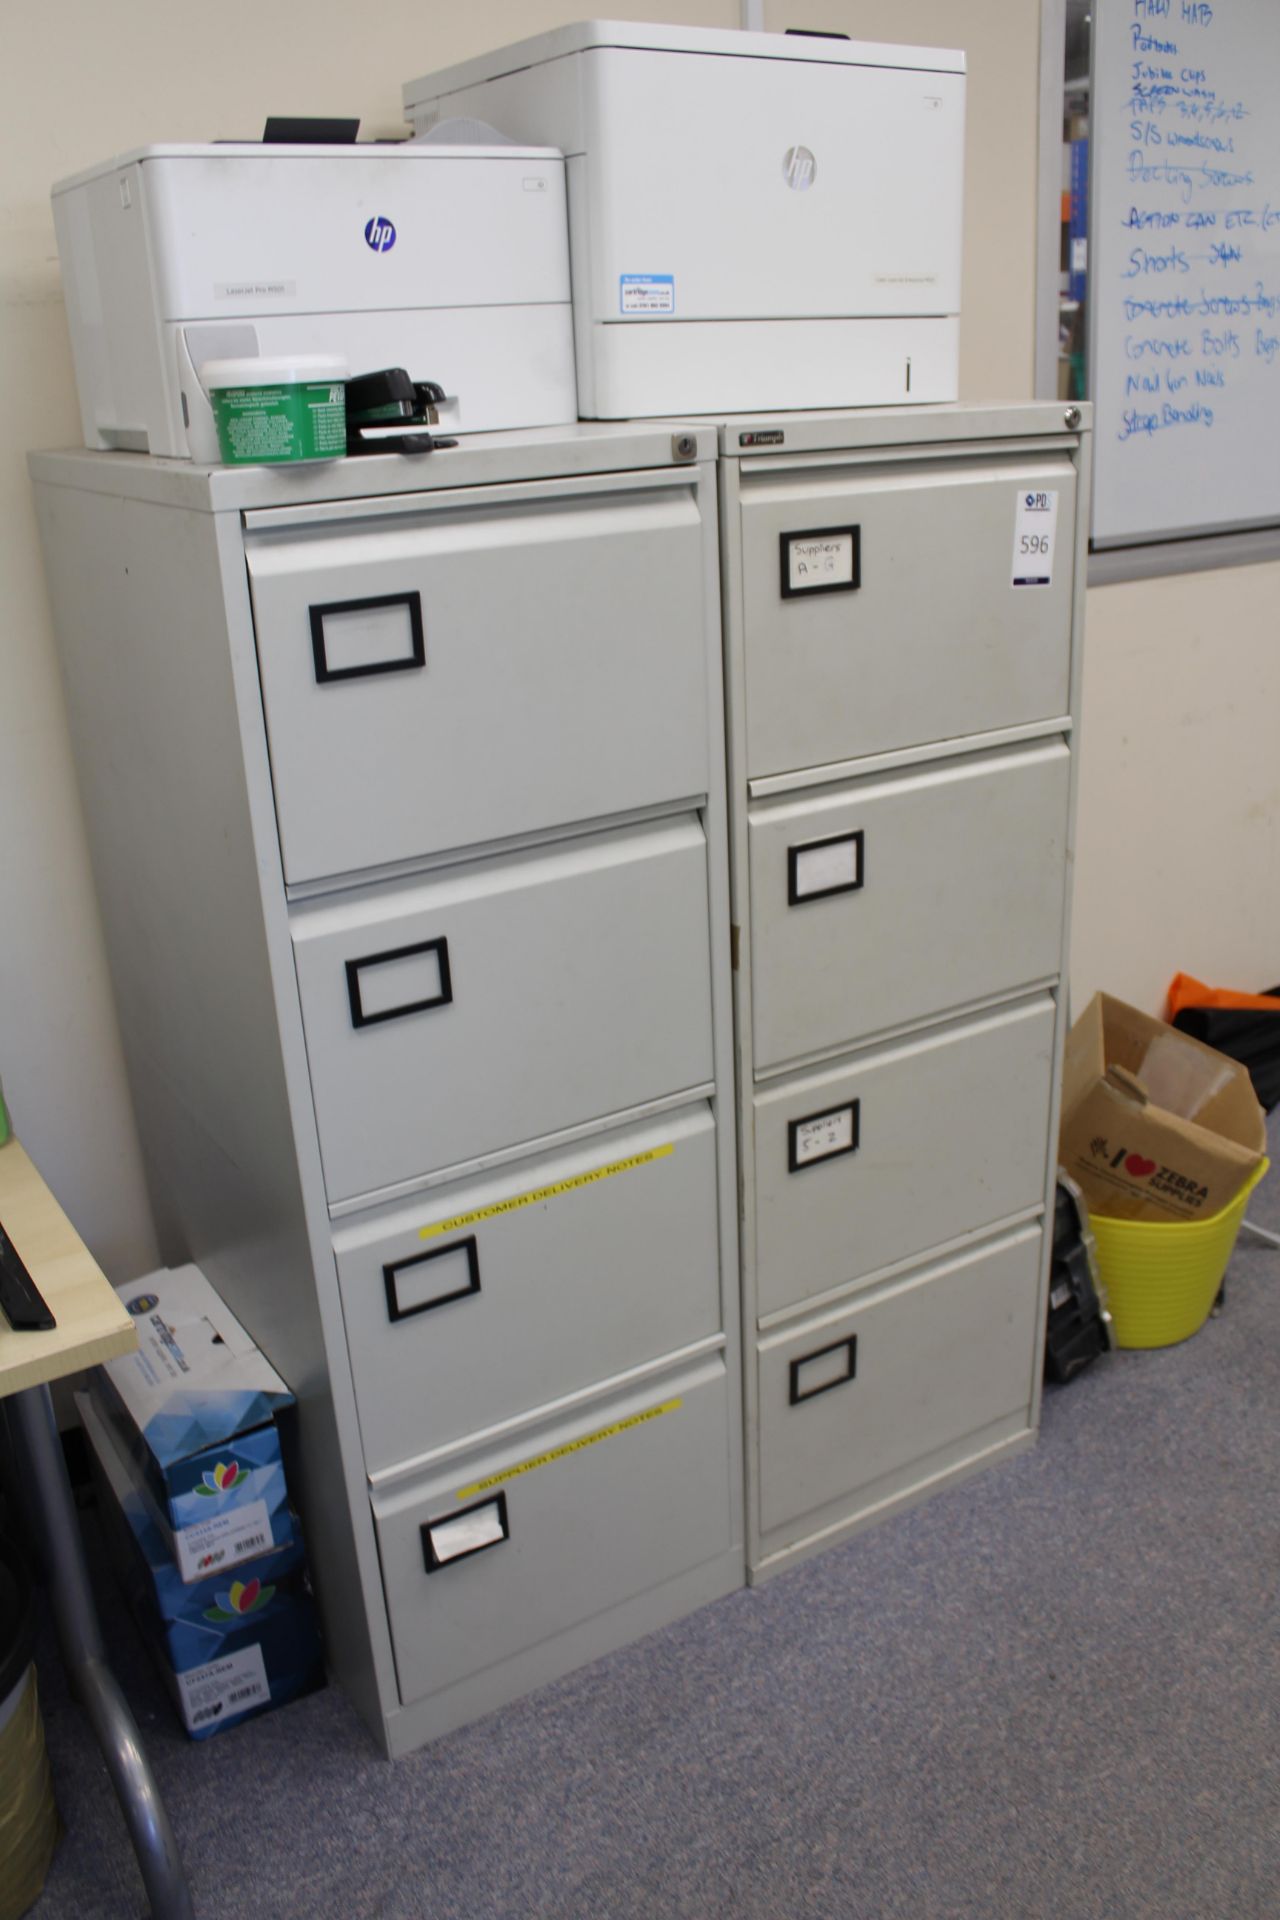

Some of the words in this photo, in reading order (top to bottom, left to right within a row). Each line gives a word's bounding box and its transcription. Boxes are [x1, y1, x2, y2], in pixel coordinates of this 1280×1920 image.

[367, 216, 395, 253] hp
[794, 542, 842, 557] Suppliers
[1020, 535, 1049, 554] 596
[797, 562, 808, 575] A
[1110, 1147, 1127, 1168] I
[442, 1194, 529, 1231] CUSTOMER
[532, 1170, 603, 1201] DELIVERY
[606, 1151, 654, 1175] NOTES
[1156, 1165, 1209, 1199] ZEBRA
[549, 1427, 614, 1460] DELIVERY
[617, 1407, 663, 1431] NOTES
